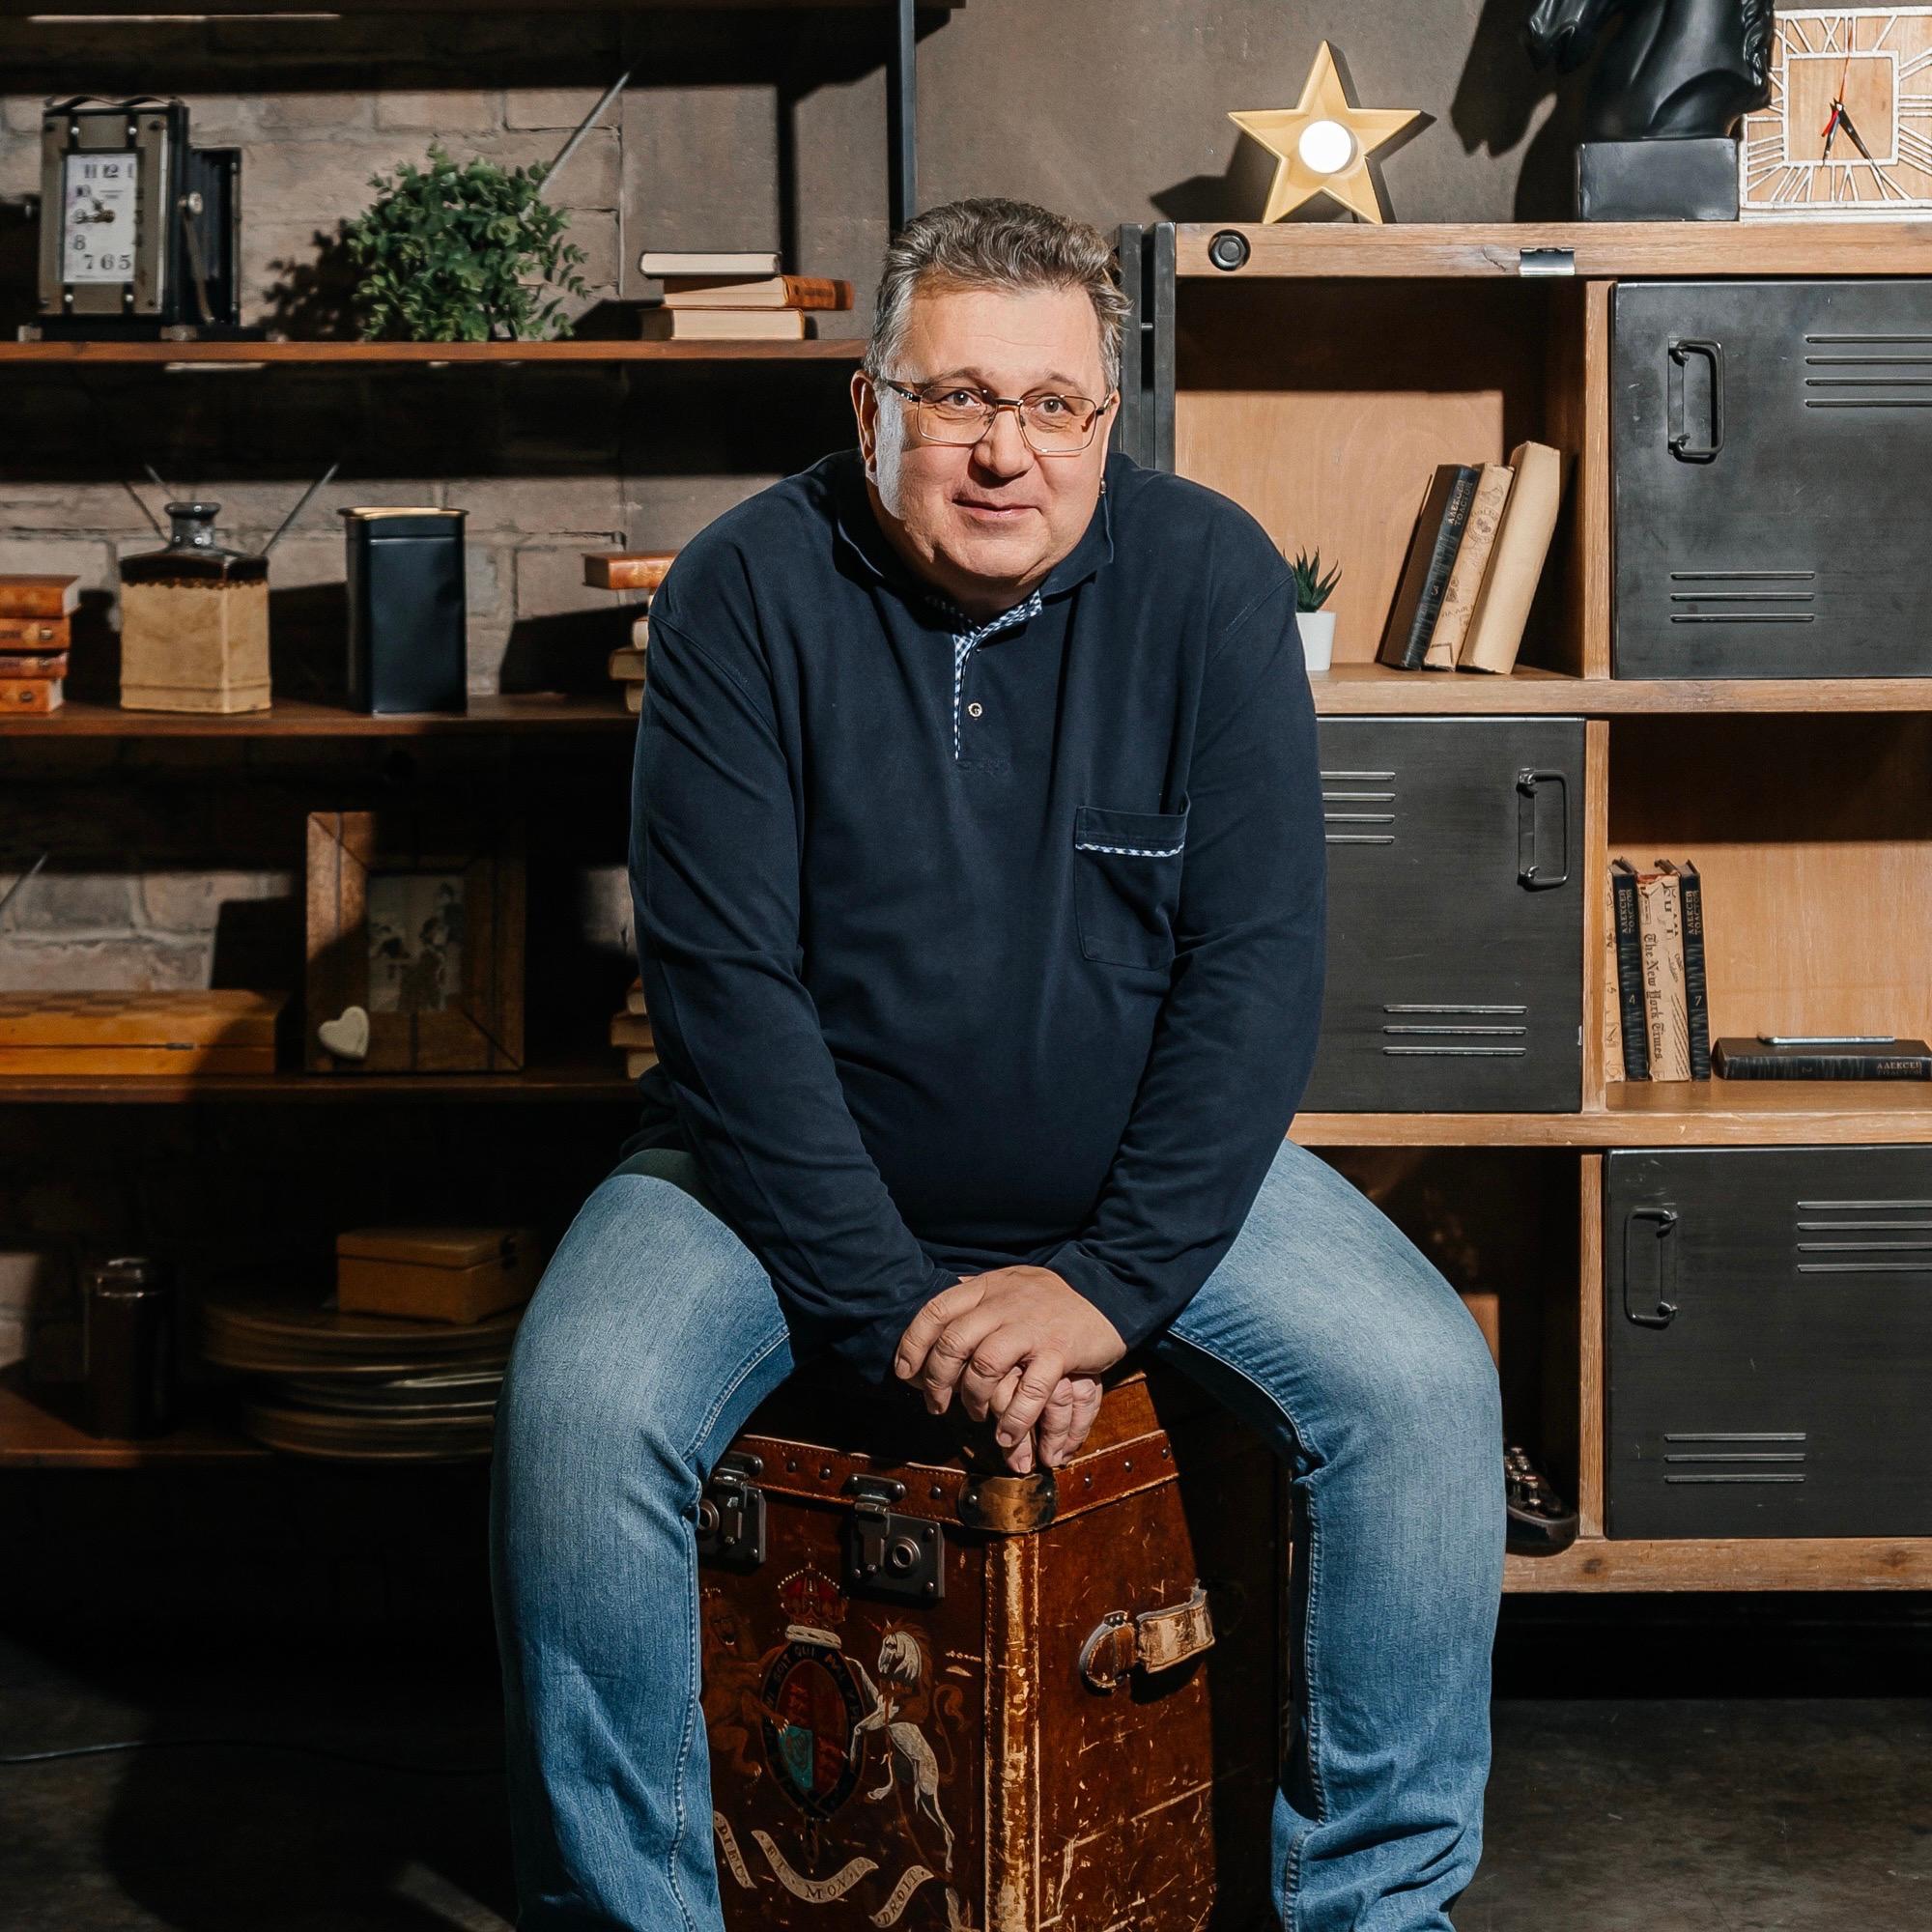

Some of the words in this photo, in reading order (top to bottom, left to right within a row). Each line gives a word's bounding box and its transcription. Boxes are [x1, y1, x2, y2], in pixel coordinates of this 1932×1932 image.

[1818, 16, 1858, 53] XII
[1872, 15, 1898, 52] I
[84, 164, 98, 179] 11
[103, 163, 119, 179] 12
[1770, 166, 1813, 202] VII
[1829, 166, 1860, 202] VI
[76, 185, 91, 197] 10
[73, 234, 86, 250] 8
[84, 254, 94, 270] 7
[100, 254, 115, 270] 6
[119, 255, 131, 270] 5
[1618, 889, 1629, 934] АЛЕКСЕЙ
[1686, 890, 1695, 935] АЛЕКСЕЙ
[1643, 933, 1657, 957] The
[1645, 960, 1660, 986] New
[1629, 994, 1636, 1005] 4
[1646, 989, 1663, 1019] York
[805, 1875, 847, 1899] MON
[881, 1869, 918, 1924] DROIT
